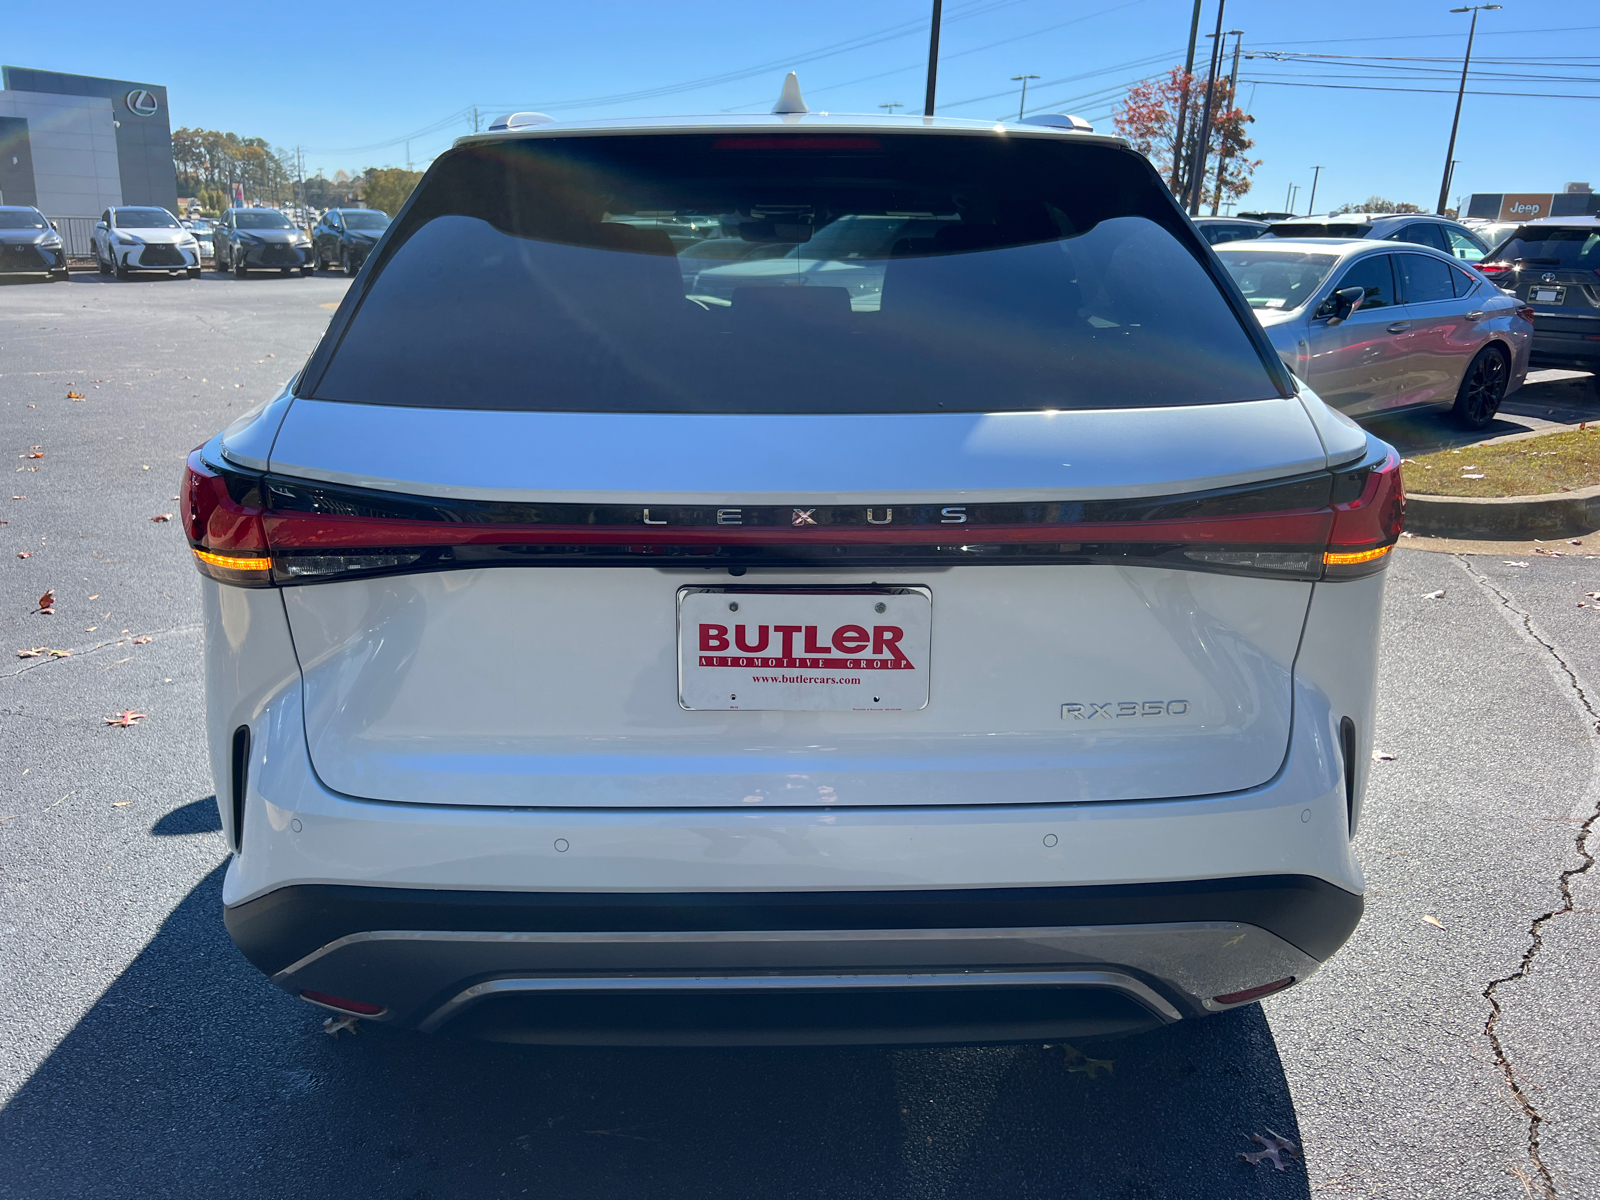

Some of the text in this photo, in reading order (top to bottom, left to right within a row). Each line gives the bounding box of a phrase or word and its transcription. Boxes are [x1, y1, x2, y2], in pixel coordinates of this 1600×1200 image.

[1510, 201, 1540, 216] Jeep
[643, 507, 968, 525] LEXUS
[700, 657, 907, 669] AUTOMOTIVE GROUP
[752, 674, 861, 685] www.butlercars.com
